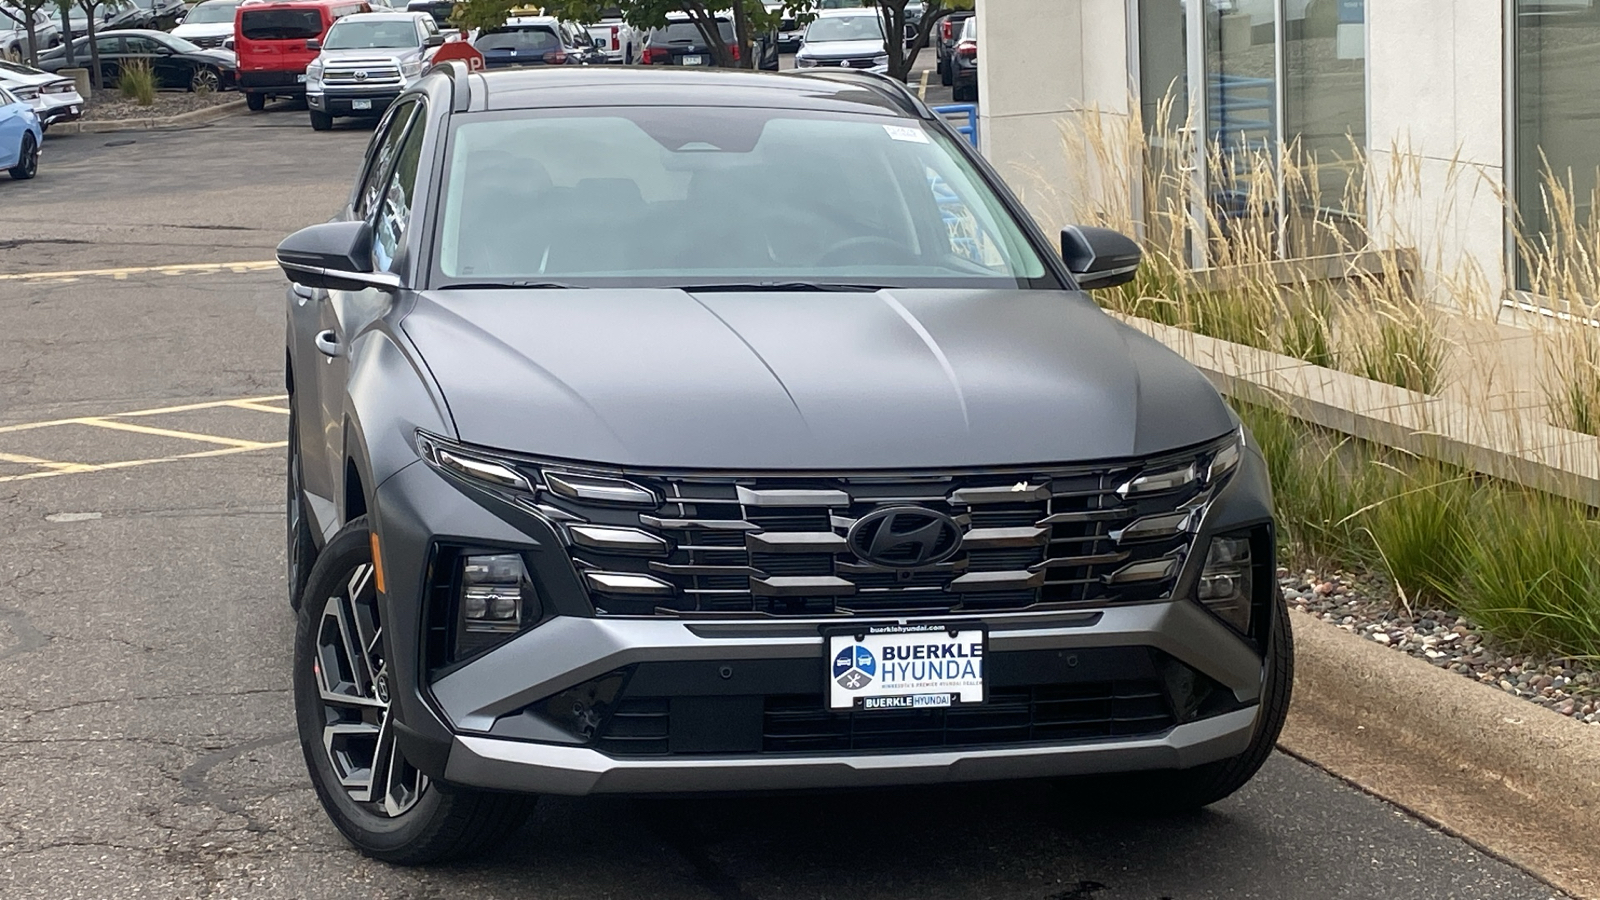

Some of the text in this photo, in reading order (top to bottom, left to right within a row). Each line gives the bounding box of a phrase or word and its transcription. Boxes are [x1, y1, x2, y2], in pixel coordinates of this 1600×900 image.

[882, 643, 982, 661] BUERKLE
[865, 695, 950, 708] BUERKLE HYUNDAI
